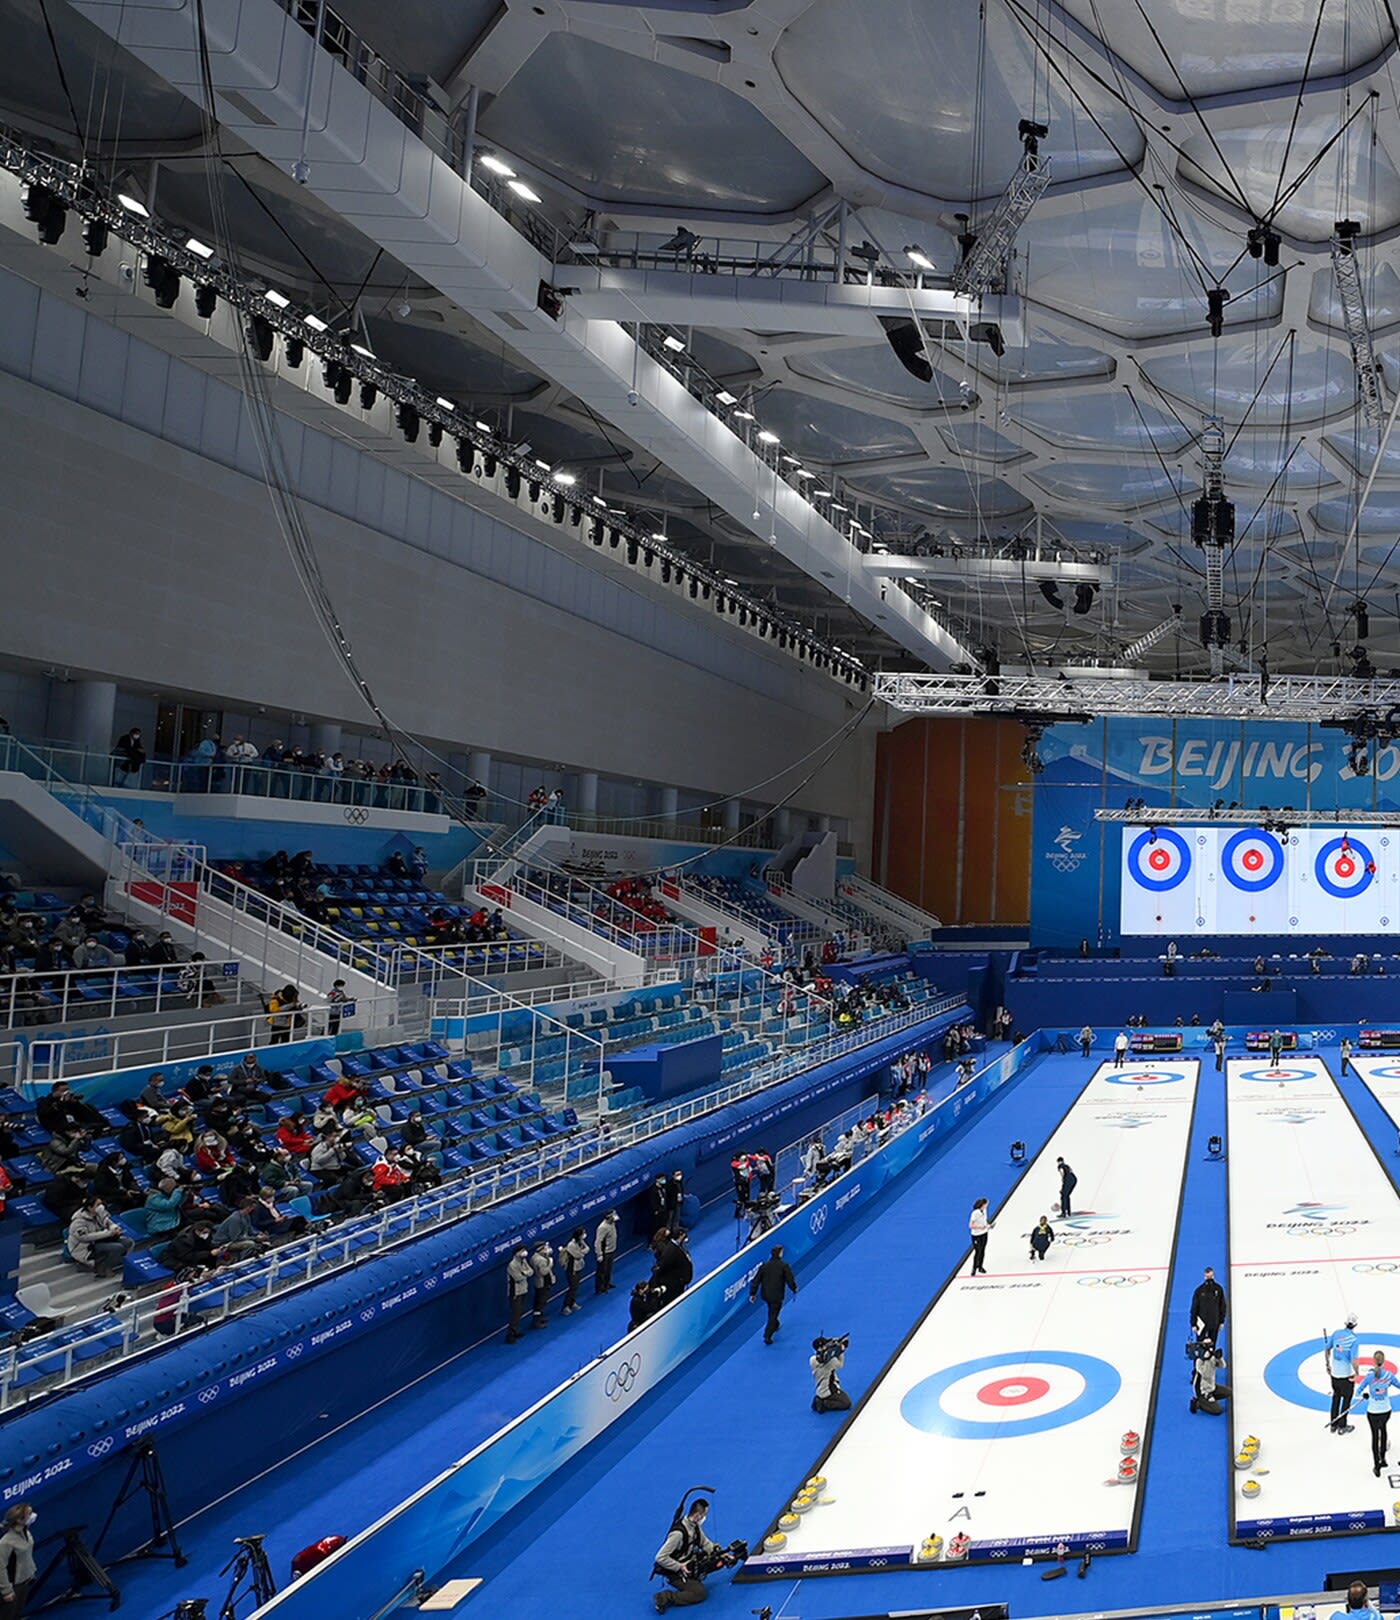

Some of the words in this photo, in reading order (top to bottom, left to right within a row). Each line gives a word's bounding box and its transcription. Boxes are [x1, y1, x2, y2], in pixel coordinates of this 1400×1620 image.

[1138, 735, 1324, 790] BEIJING
[311, 1328, 334, 1345] BEIJING
[335, 1320, 353, 1333] 2022
[229, 1368, 256, 1387] BEIJING
[257, 1358, 277, 1374] 2022
[125, 1415, 158, 1438] BEIJING
[160, 1403, 186, 1421] 2022
[3, 1472, 42, 1500] BEIJING
[45, 1459, 73, 1480] 2022
[948, 1506, 971, 1522] A
[1289, 1527, 1313, 1536] BEIJING
[1314, 1525, 1333, 1534] 2022
